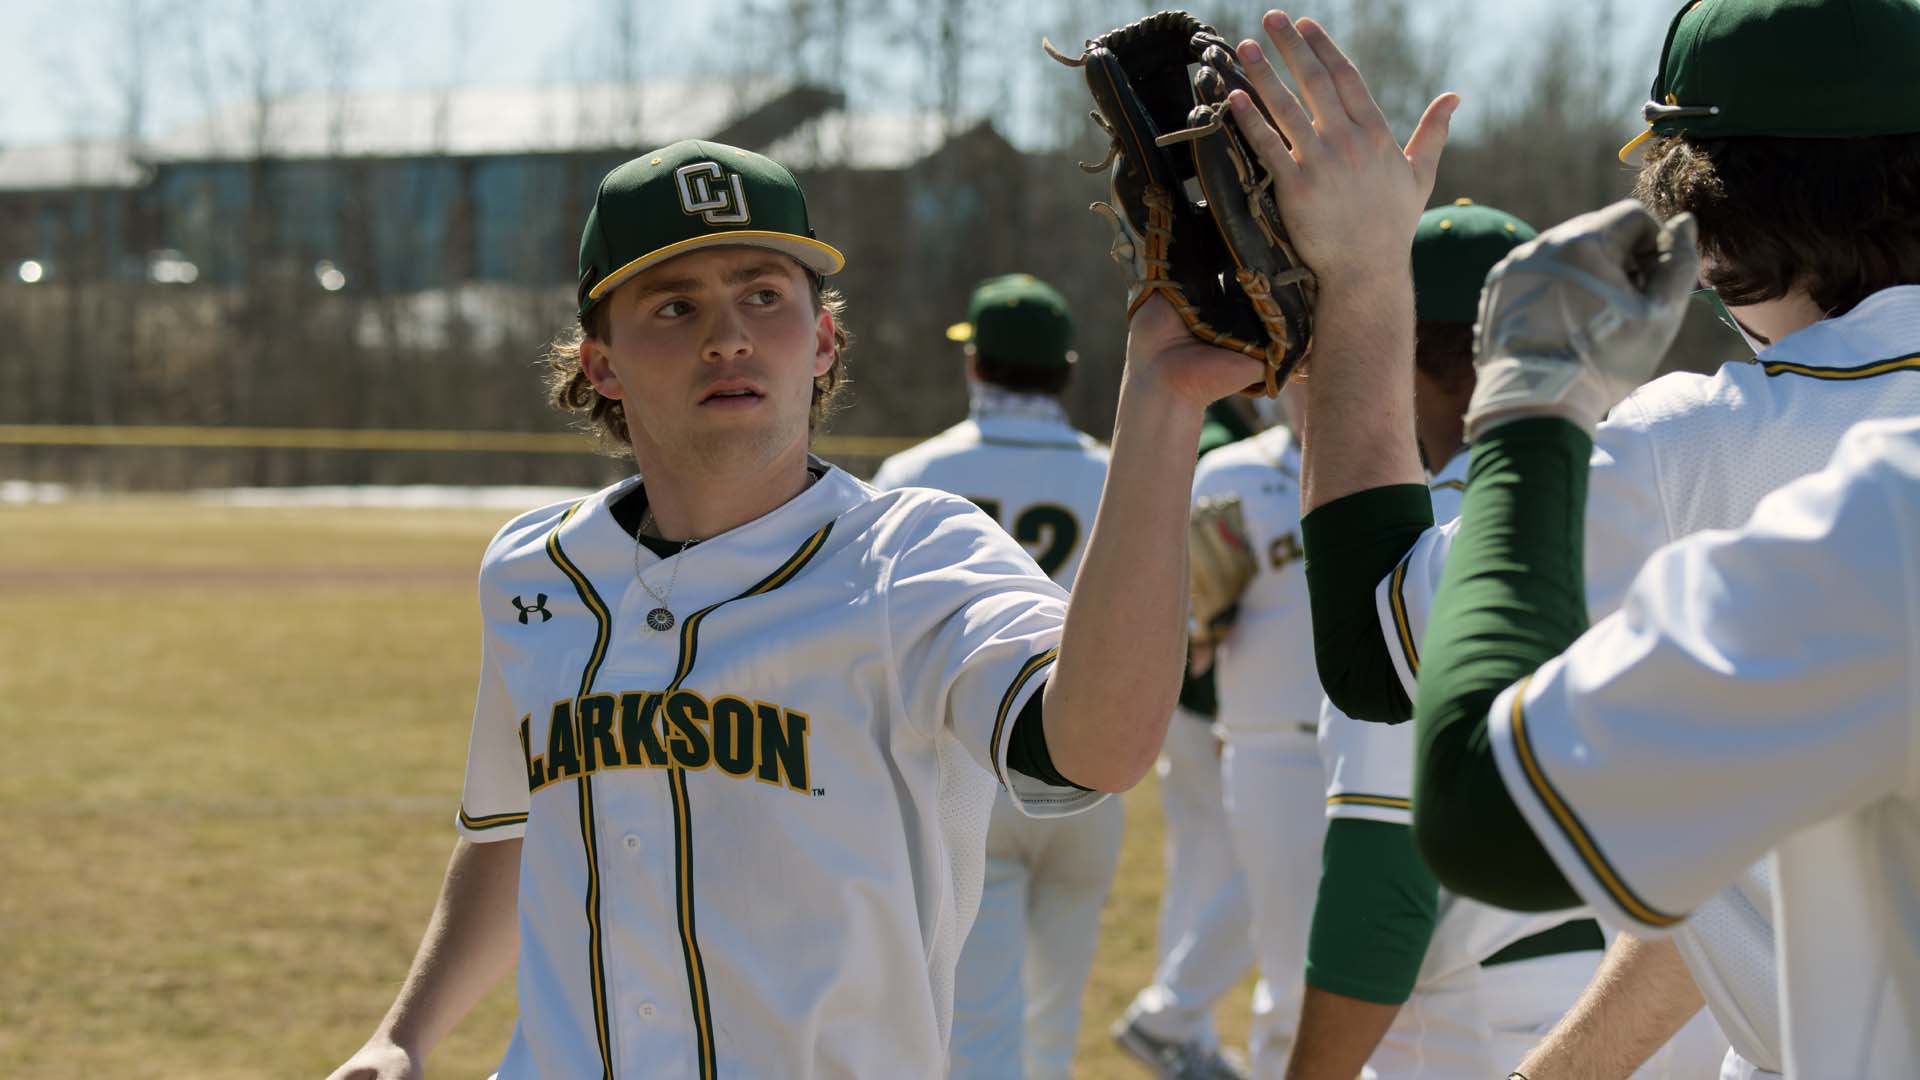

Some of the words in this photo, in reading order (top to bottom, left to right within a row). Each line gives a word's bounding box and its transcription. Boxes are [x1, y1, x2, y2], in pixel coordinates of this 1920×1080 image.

[965, 496, 1080, 578] 2
[517, 688, 811, 796] LARKSON
[812, 788, 825, 797] TM
